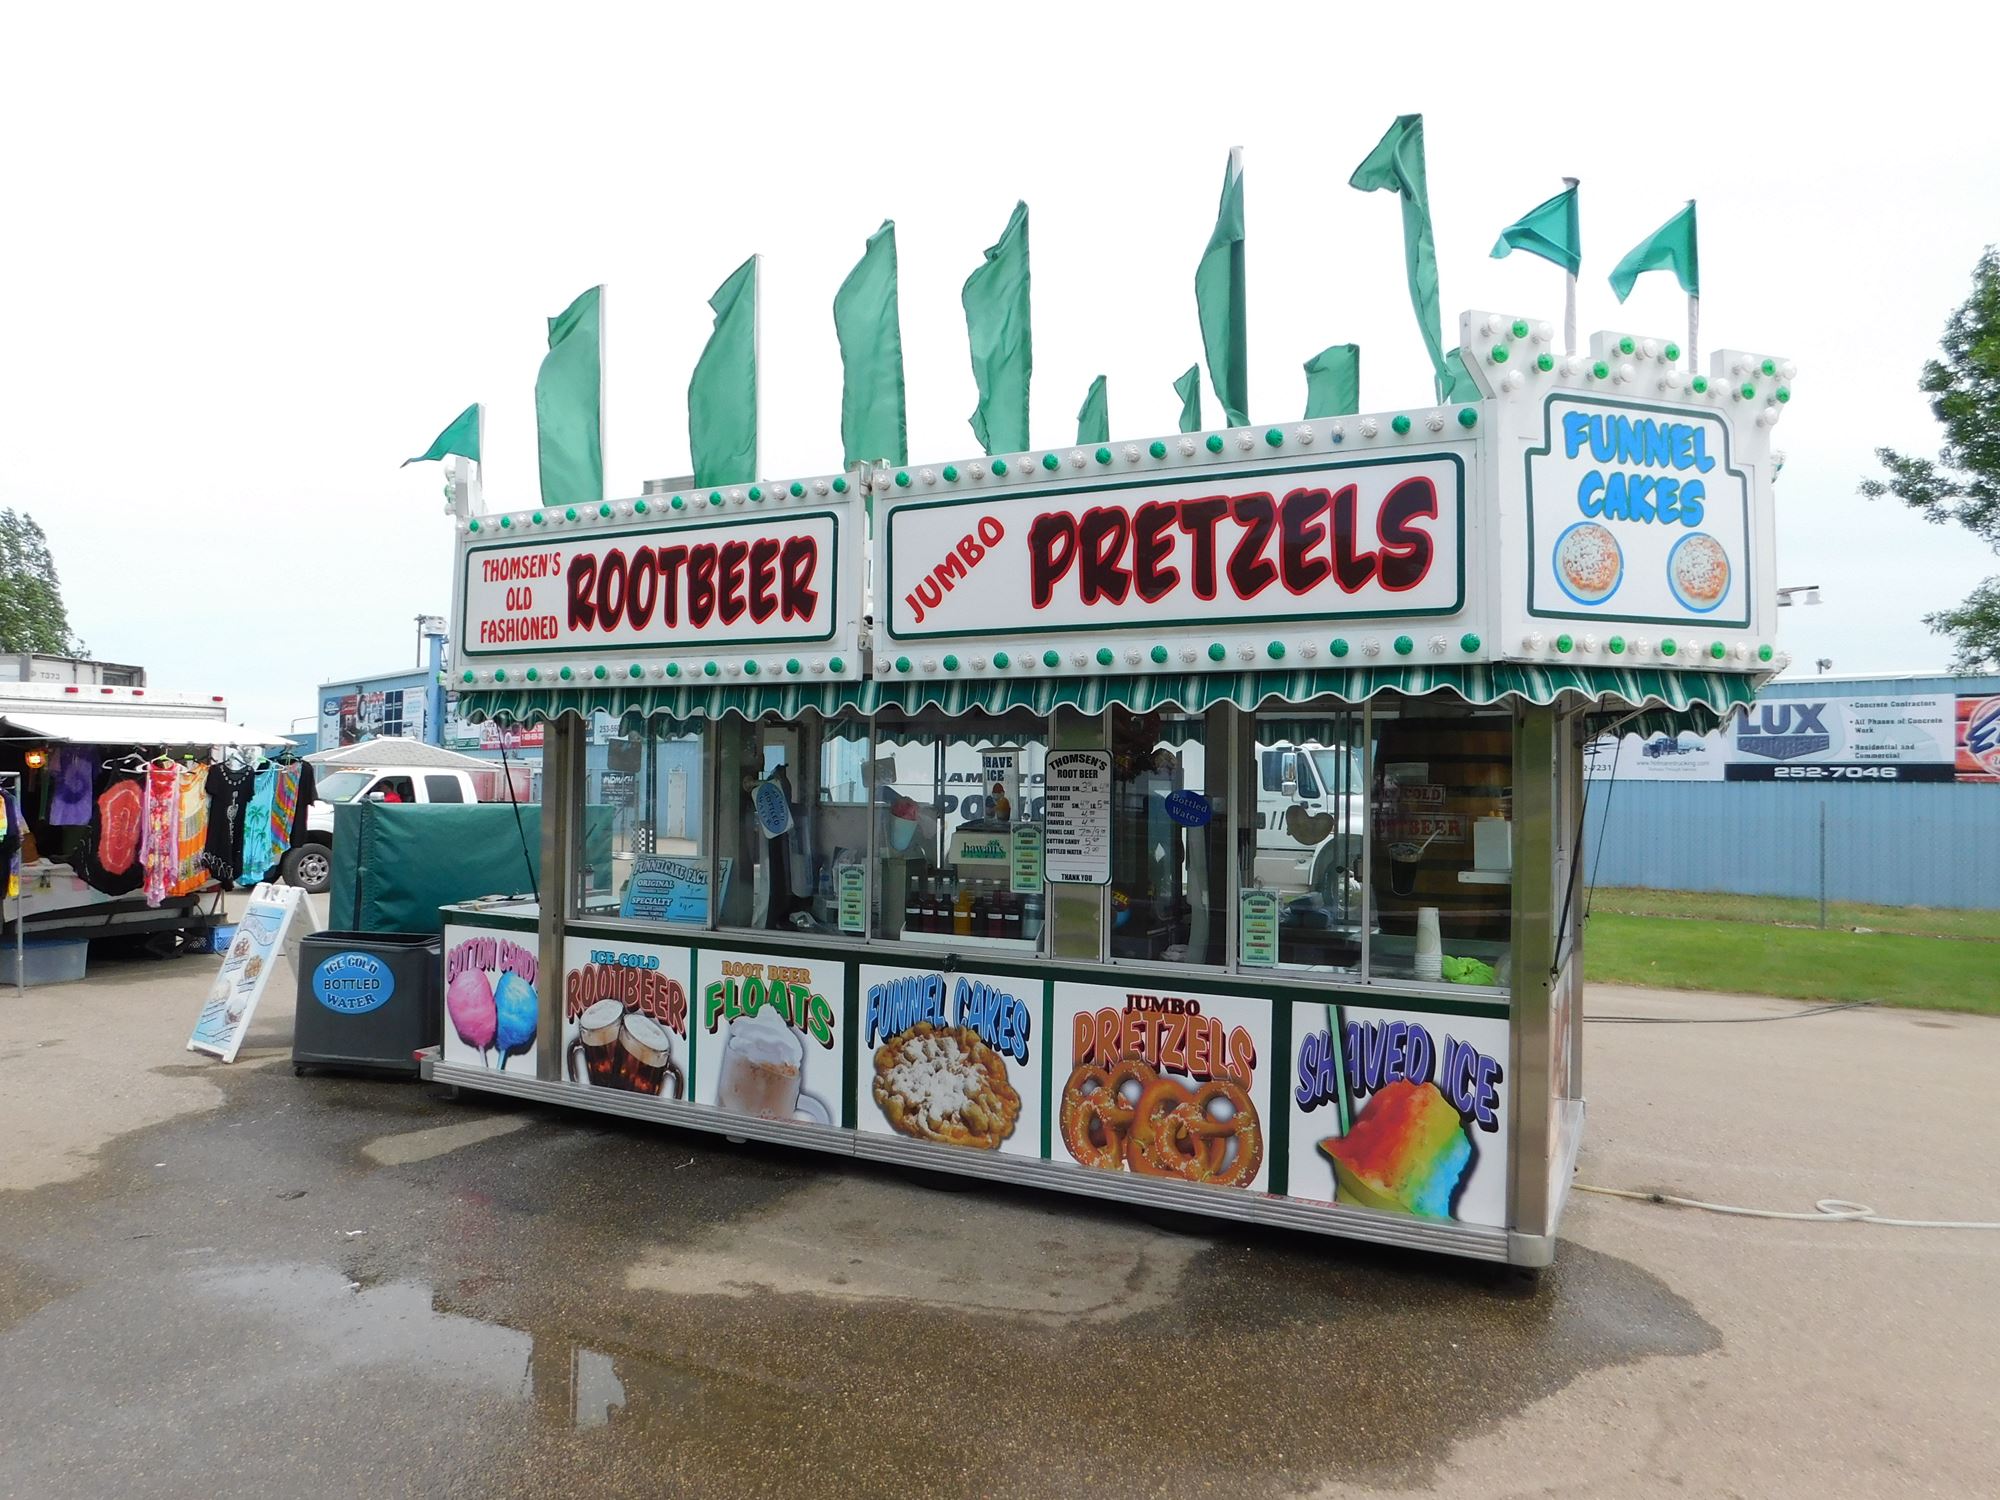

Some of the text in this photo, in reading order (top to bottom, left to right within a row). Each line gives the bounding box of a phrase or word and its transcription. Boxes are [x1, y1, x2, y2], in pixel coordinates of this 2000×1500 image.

[1562, 411, 1716, 474] FUNNEL
[1577, 470, 1706, 528] CAKES
[1027, 476, 1438, 610] PRETZELS
[482, 552, 561, 583] THOMSEN'S
[904, 516, 1006, 624] JUMBO
[566, 535, 818, 633] ROOTBEER
[505, 587, 533, 611] OLD
[480, 615, 559, 644] FASHIONED
[1737, 703, 1829, 734] LUX
[1048, 753, 1108, 771] THOMSEN'S
[1057, 769, 1099, 779] ROOT BEER
[1773, 767, 1897, 778] 252-7046
[987, 770, 1005, 782] ICE
[1172, 793, 1208, 813] Bottled
[1172, 806, 1200, 823] Water
[637, 879, 674, 889] ORIGINAL
[1061, 873, 1081, 881] THANK
[631, 896, 673, 907] SPECIALTY
[325, 956, 379, 975] ICE COLD
[447, 937, 539, 986] COTTON CAND
[590, 950, 660, 970] ICE COLD
[722, 960, 812, 984] ROOT BEER
[324, 978, 381, 990] BOTTLED
[326, 992, 377, 1009] WATER
[566, 962, 688, 1040] ROOTBEER
[704, 976, 836, 1049] FLOATS
[1125, 994, 1200, 1016] JUMBO
[865, 974, 1031, 1066] FUNNEL CAKES
[1072, 1007, 1257, 1092] PRETZELS
[1295, 1019, 1504, 1132] SHAVED ICE
